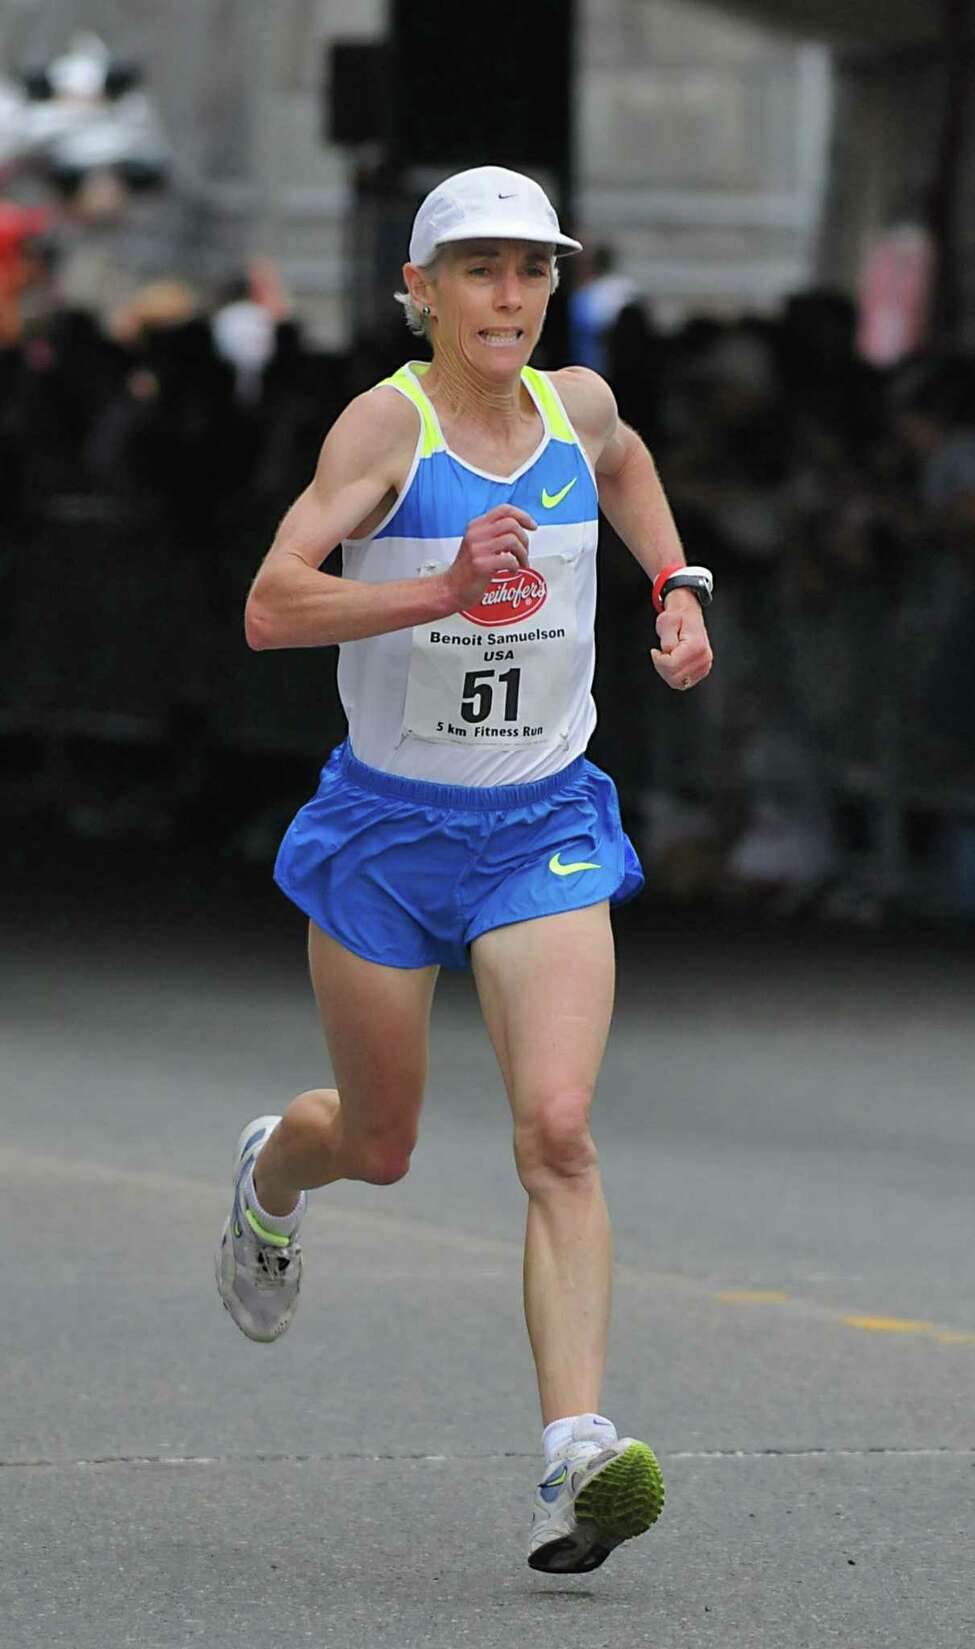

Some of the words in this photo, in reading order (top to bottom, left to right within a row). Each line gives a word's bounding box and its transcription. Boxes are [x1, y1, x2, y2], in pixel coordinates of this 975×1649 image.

[430, 631, 482, 646] Benoit
[487, 628, 565, 646] Samuelson
[483, 650, 515, 662] USA
[460, 667, 521, 724] 51
[436, 721, 444, 732] 5
[447, 722, 467, 737] km
[474, 725, 519, 737] Fitness
[523, 725, 543, 736] Run
